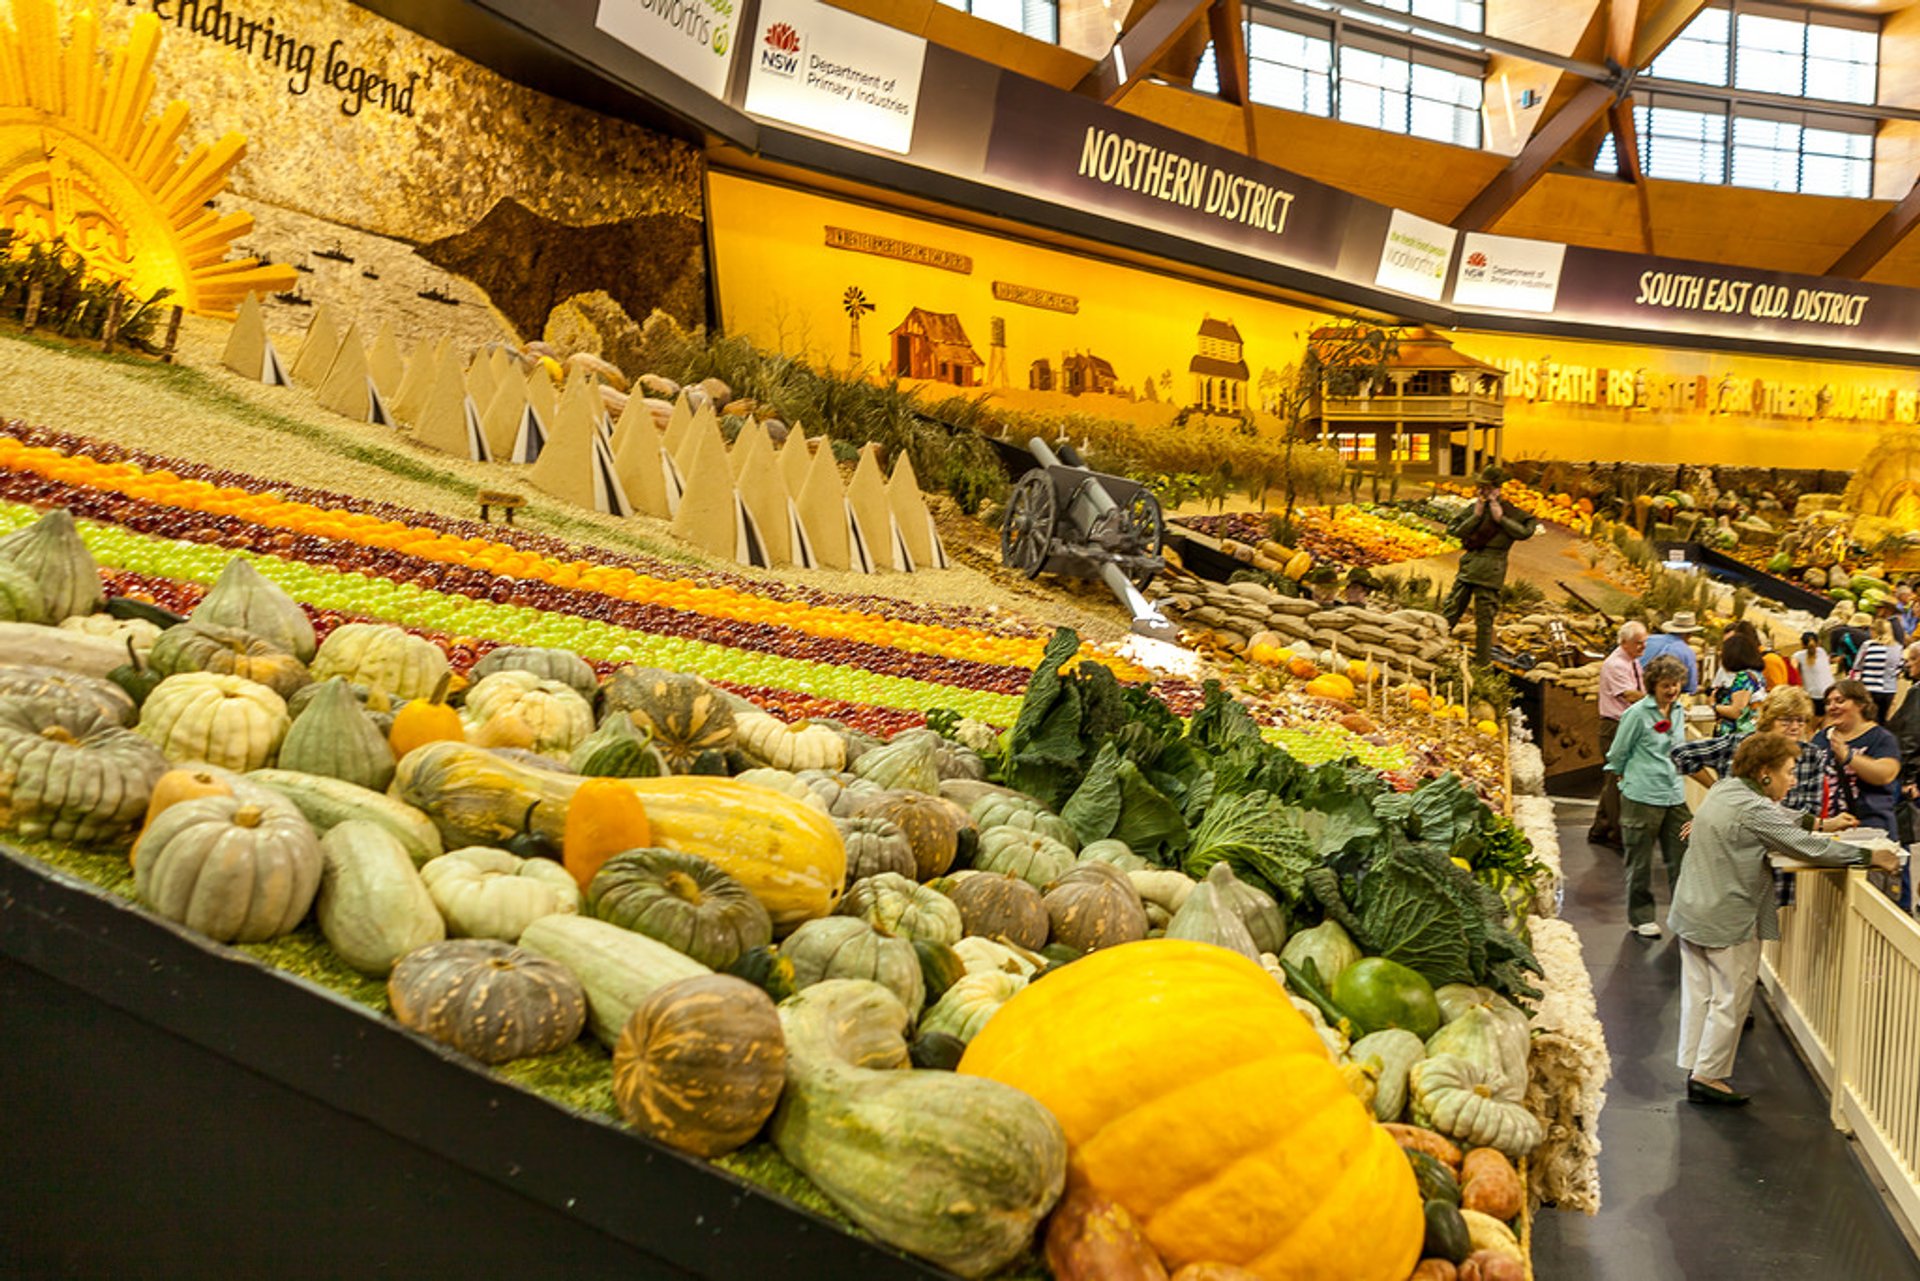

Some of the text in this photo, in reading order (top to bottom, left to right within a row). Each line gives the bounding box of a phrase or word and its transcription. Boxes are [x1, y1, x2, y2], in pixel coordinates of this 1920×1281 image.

[152, 0, 420, 118] enduring legend
[762, 50, 798, 73] NSW
[809, 54, 881, 89] Department
[883, 79, 897, 92] of
[806, 72, 910, 115] Primary Industries
[1078, 126, 1295, 235] NORTHERN DISTRICT
[1464, 268, 1486, 279] NSW
[1492, 265, 1535, 278] Department
[1636, 271, 1870, 326] SOUTH EAST QLD. DISTRICT
[1547, 363, 1636, 407] FATHERS
